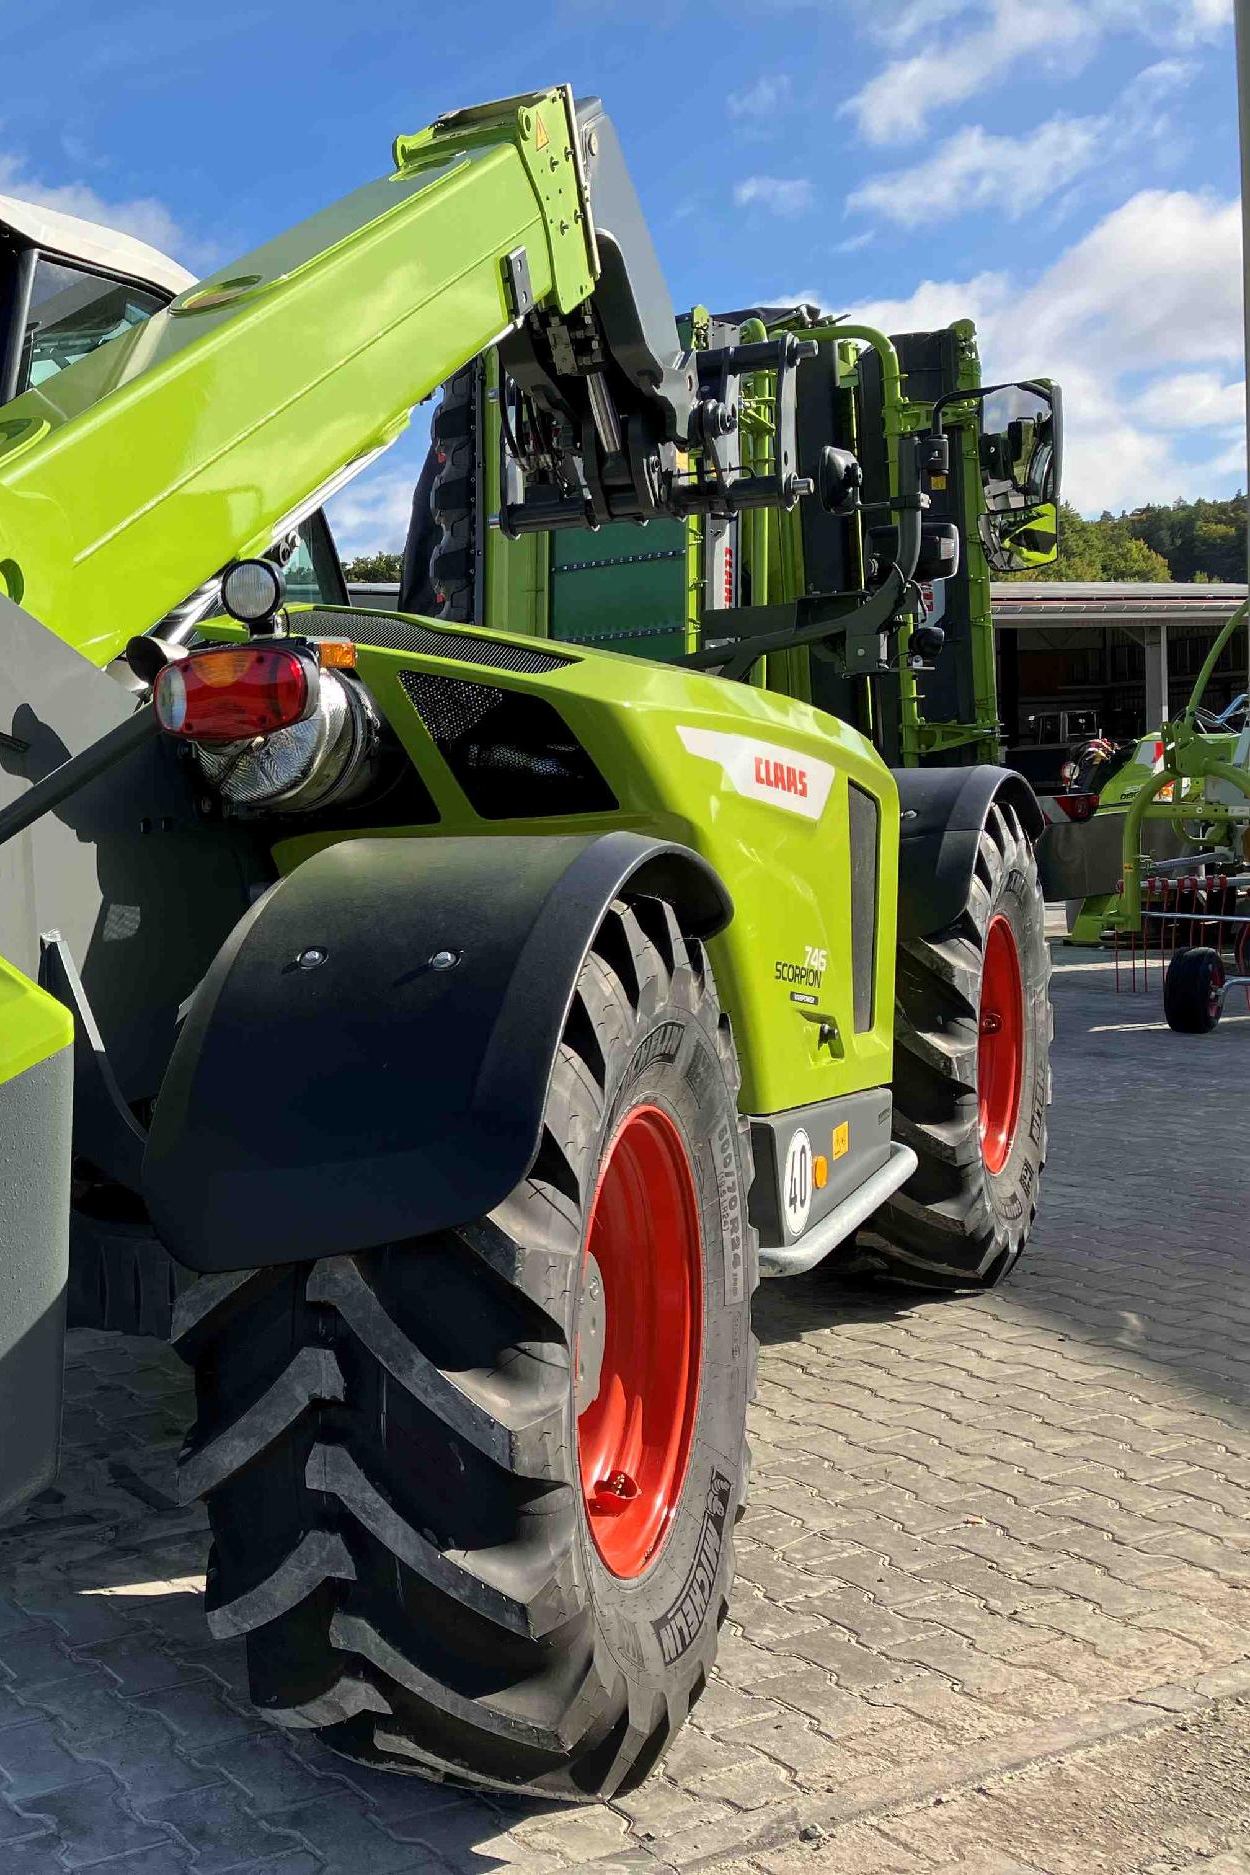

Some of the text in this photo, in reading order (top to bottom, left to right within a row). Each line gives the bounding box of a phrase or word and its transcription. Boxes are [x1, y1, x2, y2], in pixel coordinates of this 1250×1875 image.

[754, 756, 808, 798] CLAAS
[775, 961, 822, 988] SCORPION
[788, 1145, 808, 1214] 40
[659, 1517, 723, 1665] MICHELIN
